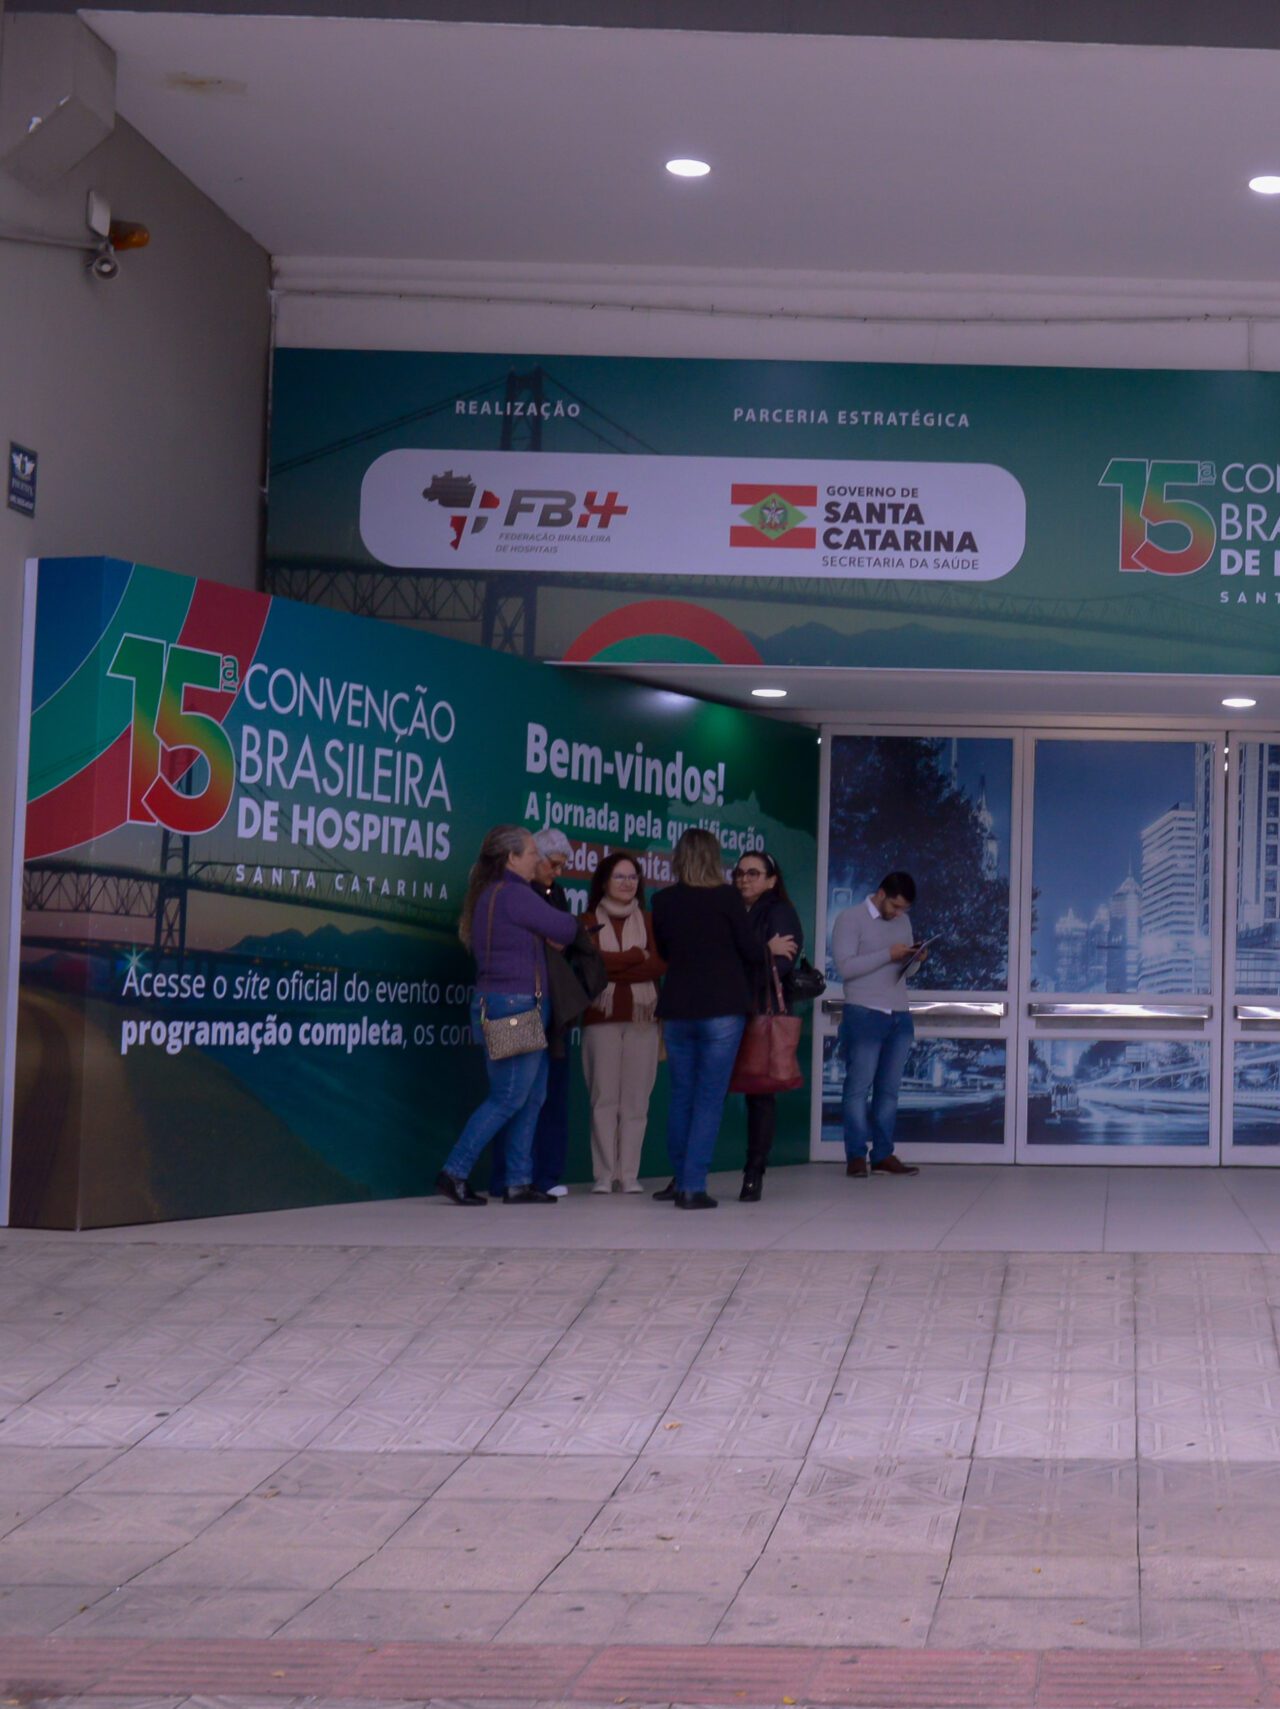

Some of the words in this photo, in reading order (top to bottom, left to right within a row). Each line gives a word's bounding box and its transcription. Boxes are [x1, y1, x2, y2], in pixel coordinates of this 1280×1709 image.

[455, 399, 581, 421] REALIZAÇÃO
[733, 407, 831, 425] PARCERIA
[838, 406, 970, 429] ESTRATÉGICA
[826, 485, 896, 498] GOVERNO
[901, 487, 919, 499] DE
[823, 501, 925, 525] SANTA
[495, 545, 507, 553] DE
[510, 545, 558, 554] HOSPITAIS
[498, 532, 556, 544] FEDERAÇÃO
[557, 533, 611, 543] BRASILEIRA
[822, 527, 979, 553] CATARINA
[822, 555, 905, 569] SECRETARIA
[909, 557, 929, 569] DA
[933, 555, 980, 570] SAÚDE
[1220, 549, 1261, 577] DE
[244, 662, 456, 744] CONVENÇÃO
[239, 725, 452, 812] BRASILEIRA
[525, 721, 726, 807] Bem-vindos!
[237, 797, 279, 842] DE
[291, 804, 451, 861] HOSPITAIS
[524, 791, 540, 821] A
[542, 792, 620, 832] jornada
[624, 810, 662, 843] pela
[564, 842, 598, 872] ede
[235, 863, 316, 890] SANTA
[335, 873, 448, 901] CATARINA
[122, 966, 206, 999] Acesse
[213, 975, 227, 998] o
[233, 968, 271, 1001] site
[276, 970, 338, 1001] oficial
[344, 971, 370, 1002] do
[375, 976, 440, 1005] evento
[121, 1014, 293, 1055] programação
[299, 1016, 407, 1049] completa,
[414, 1024, 434, 1046] os
